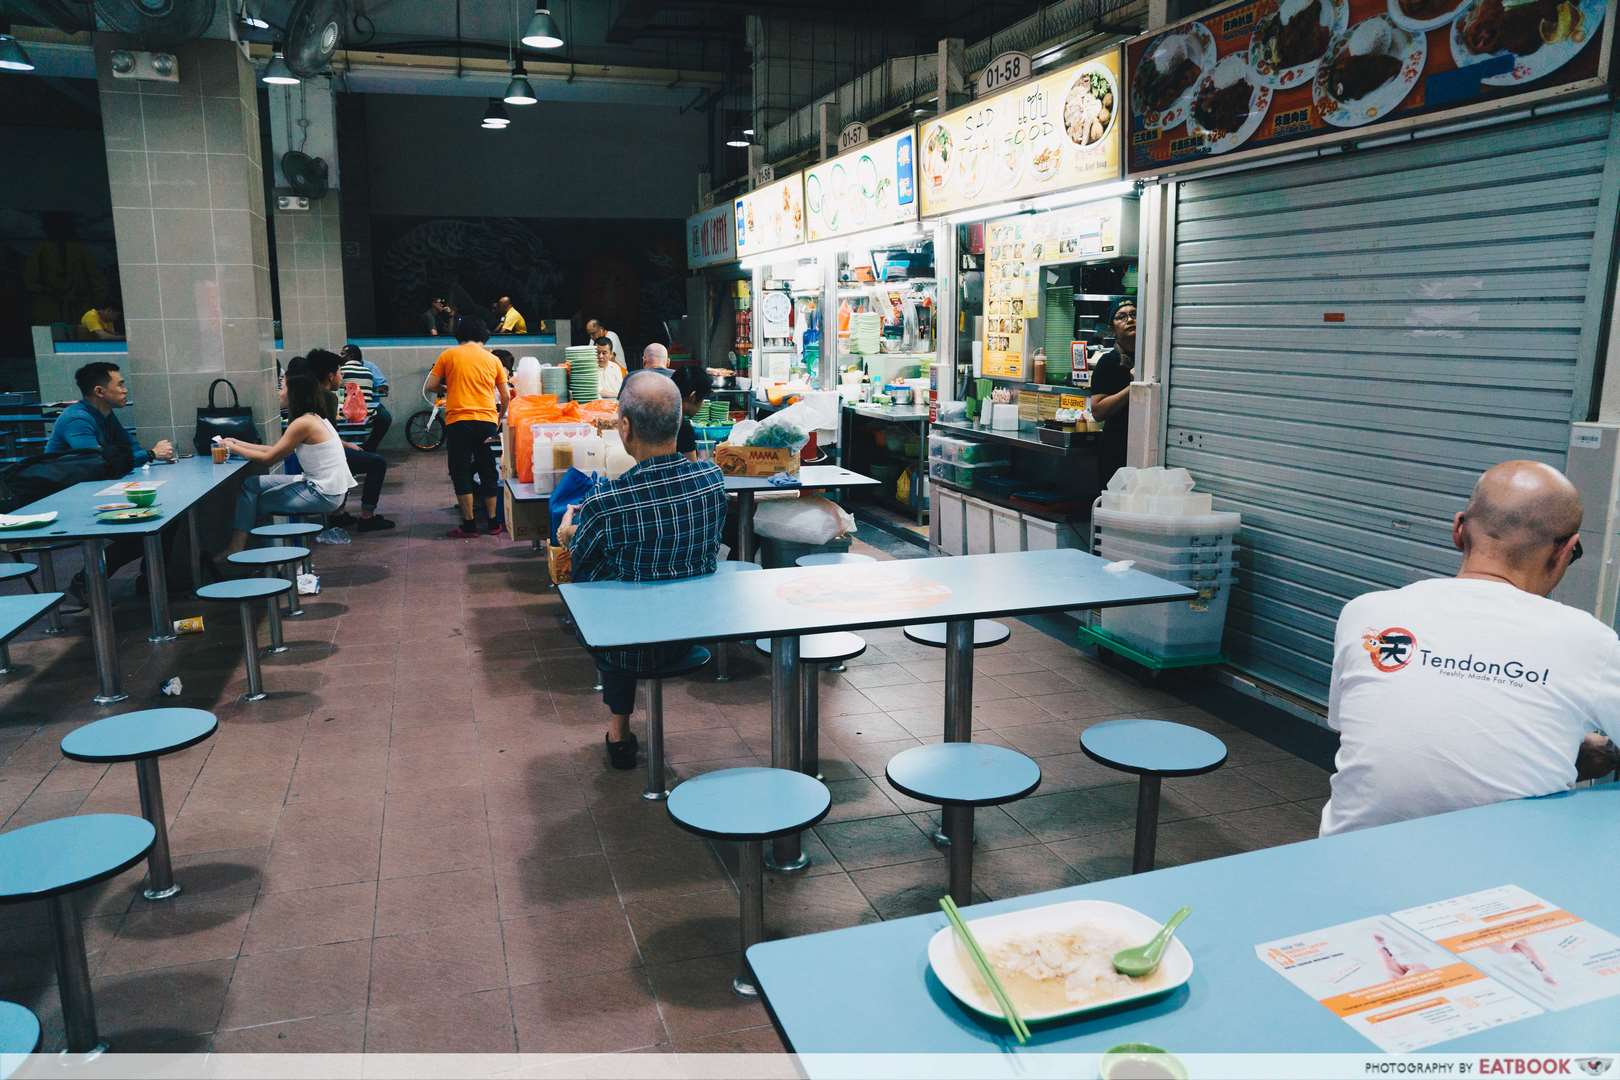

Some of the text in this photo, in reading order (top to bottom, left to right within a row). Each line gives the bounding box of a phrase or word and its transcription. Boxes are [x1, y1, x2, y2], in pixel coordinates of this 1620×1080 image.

[986, 57, 1021, 88] 01-58
[842, 126, 862, 148] 01-57
[749, 450, 780, 461] MAMA
[1419, 649, 1549, 686] TendonGo!
[1439, 669, 1523, 688] Freshly Made For You
